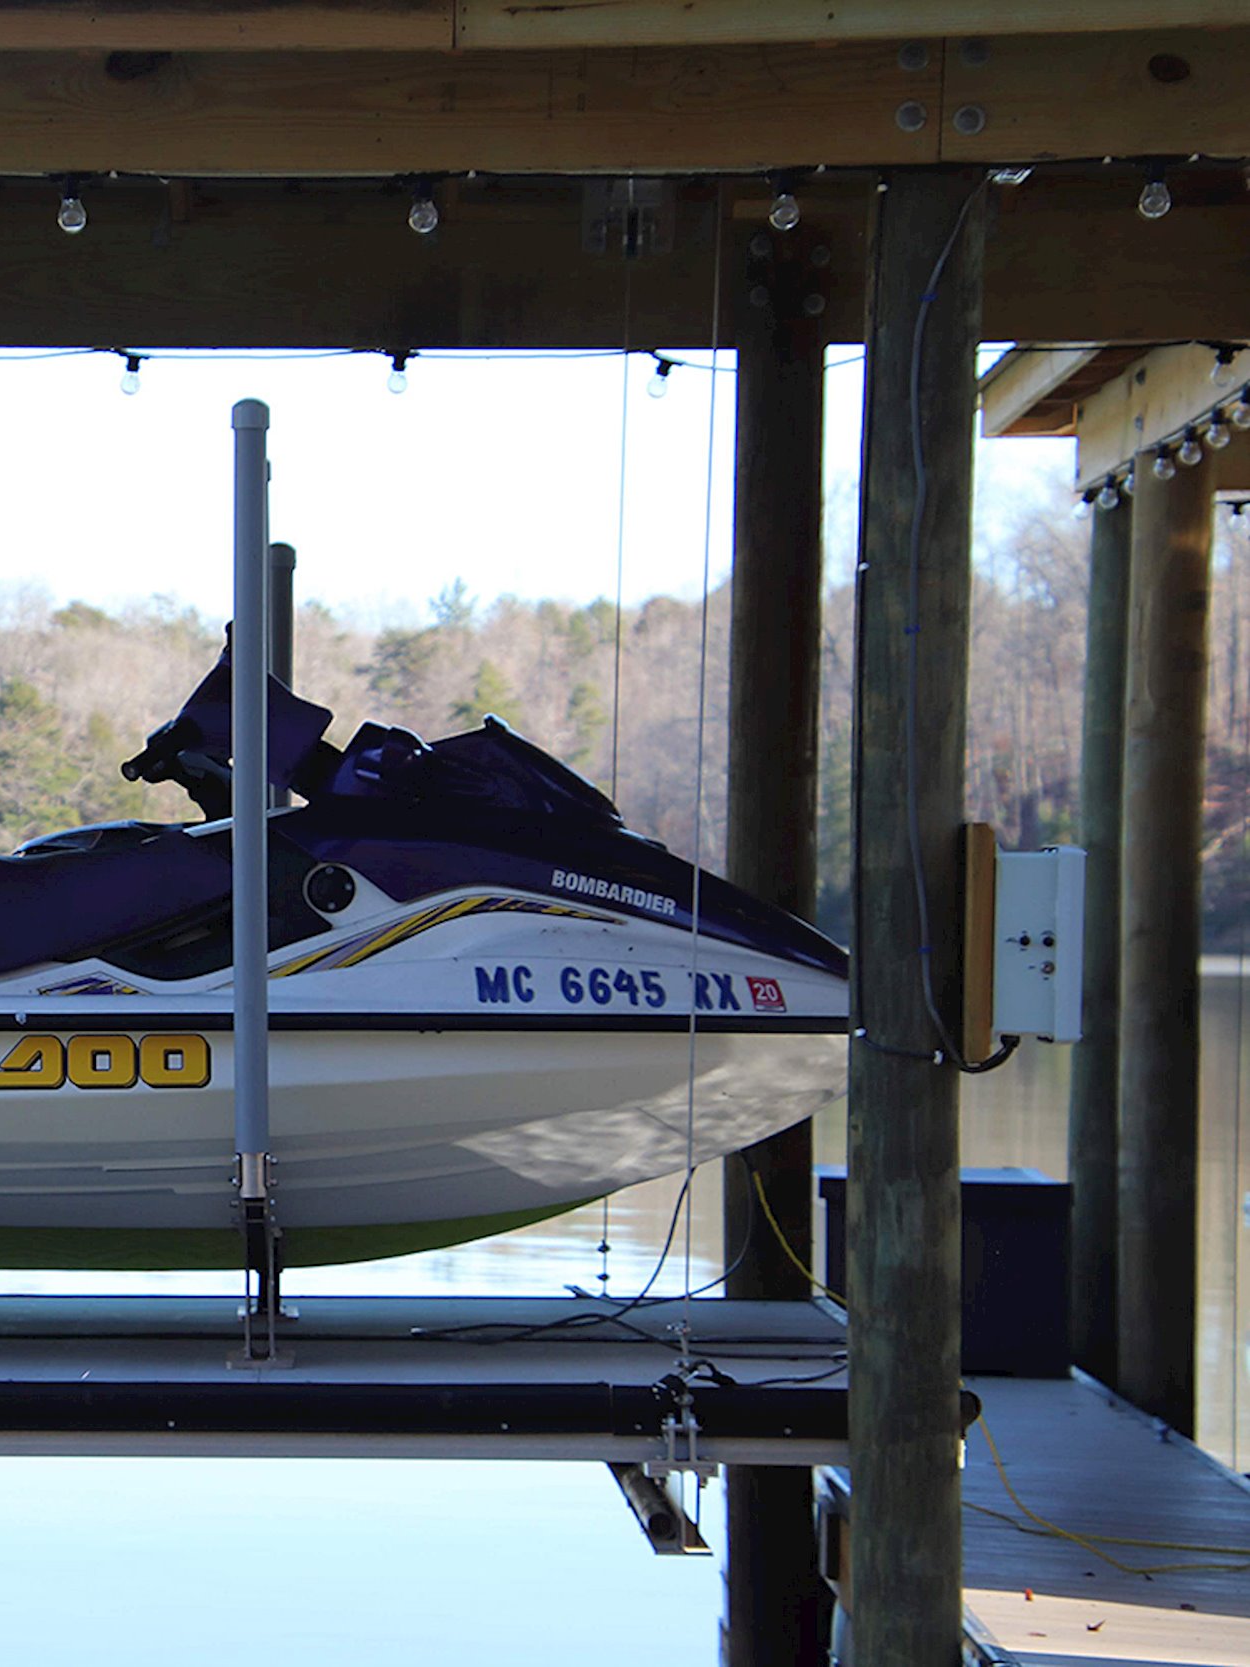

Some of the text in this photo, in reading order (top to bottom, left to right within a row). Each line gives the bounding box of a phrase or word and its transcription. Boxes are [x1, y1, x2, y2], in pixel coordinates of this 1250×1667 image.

[551, 868, 676, 916] BOMBARDIER
[474, 965, 741, 1011] MC 6645 RX
[753, 982, 779, 1002] 20
